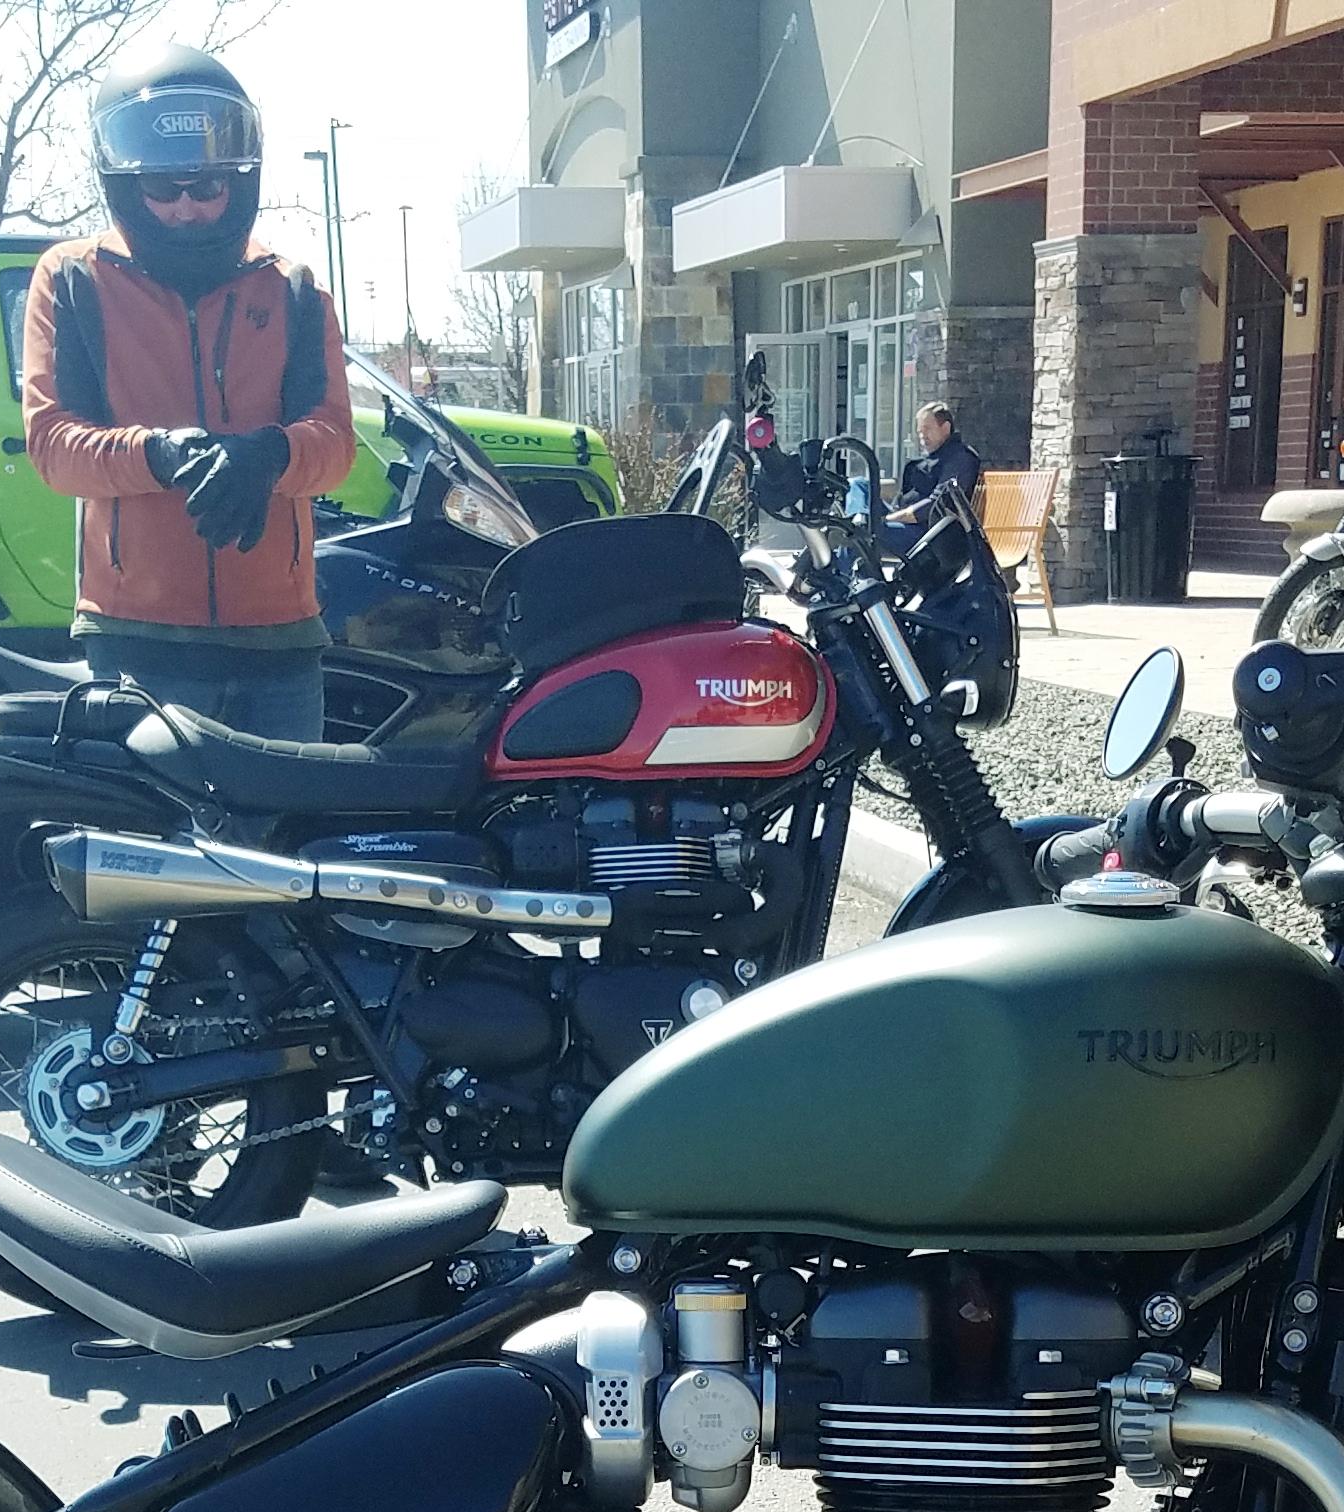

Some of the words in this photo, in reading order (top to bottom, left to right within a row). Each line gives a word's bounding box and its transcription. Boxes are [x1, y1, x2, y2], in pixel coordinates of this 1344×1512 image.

[160, 115, 209, 133] SHOEI
[365, 563, 467, 608] TROPHY
[695, 678, 792, 707] TRIUMPH
[1077, 1028, 1277, 1080] TRIUMPH
